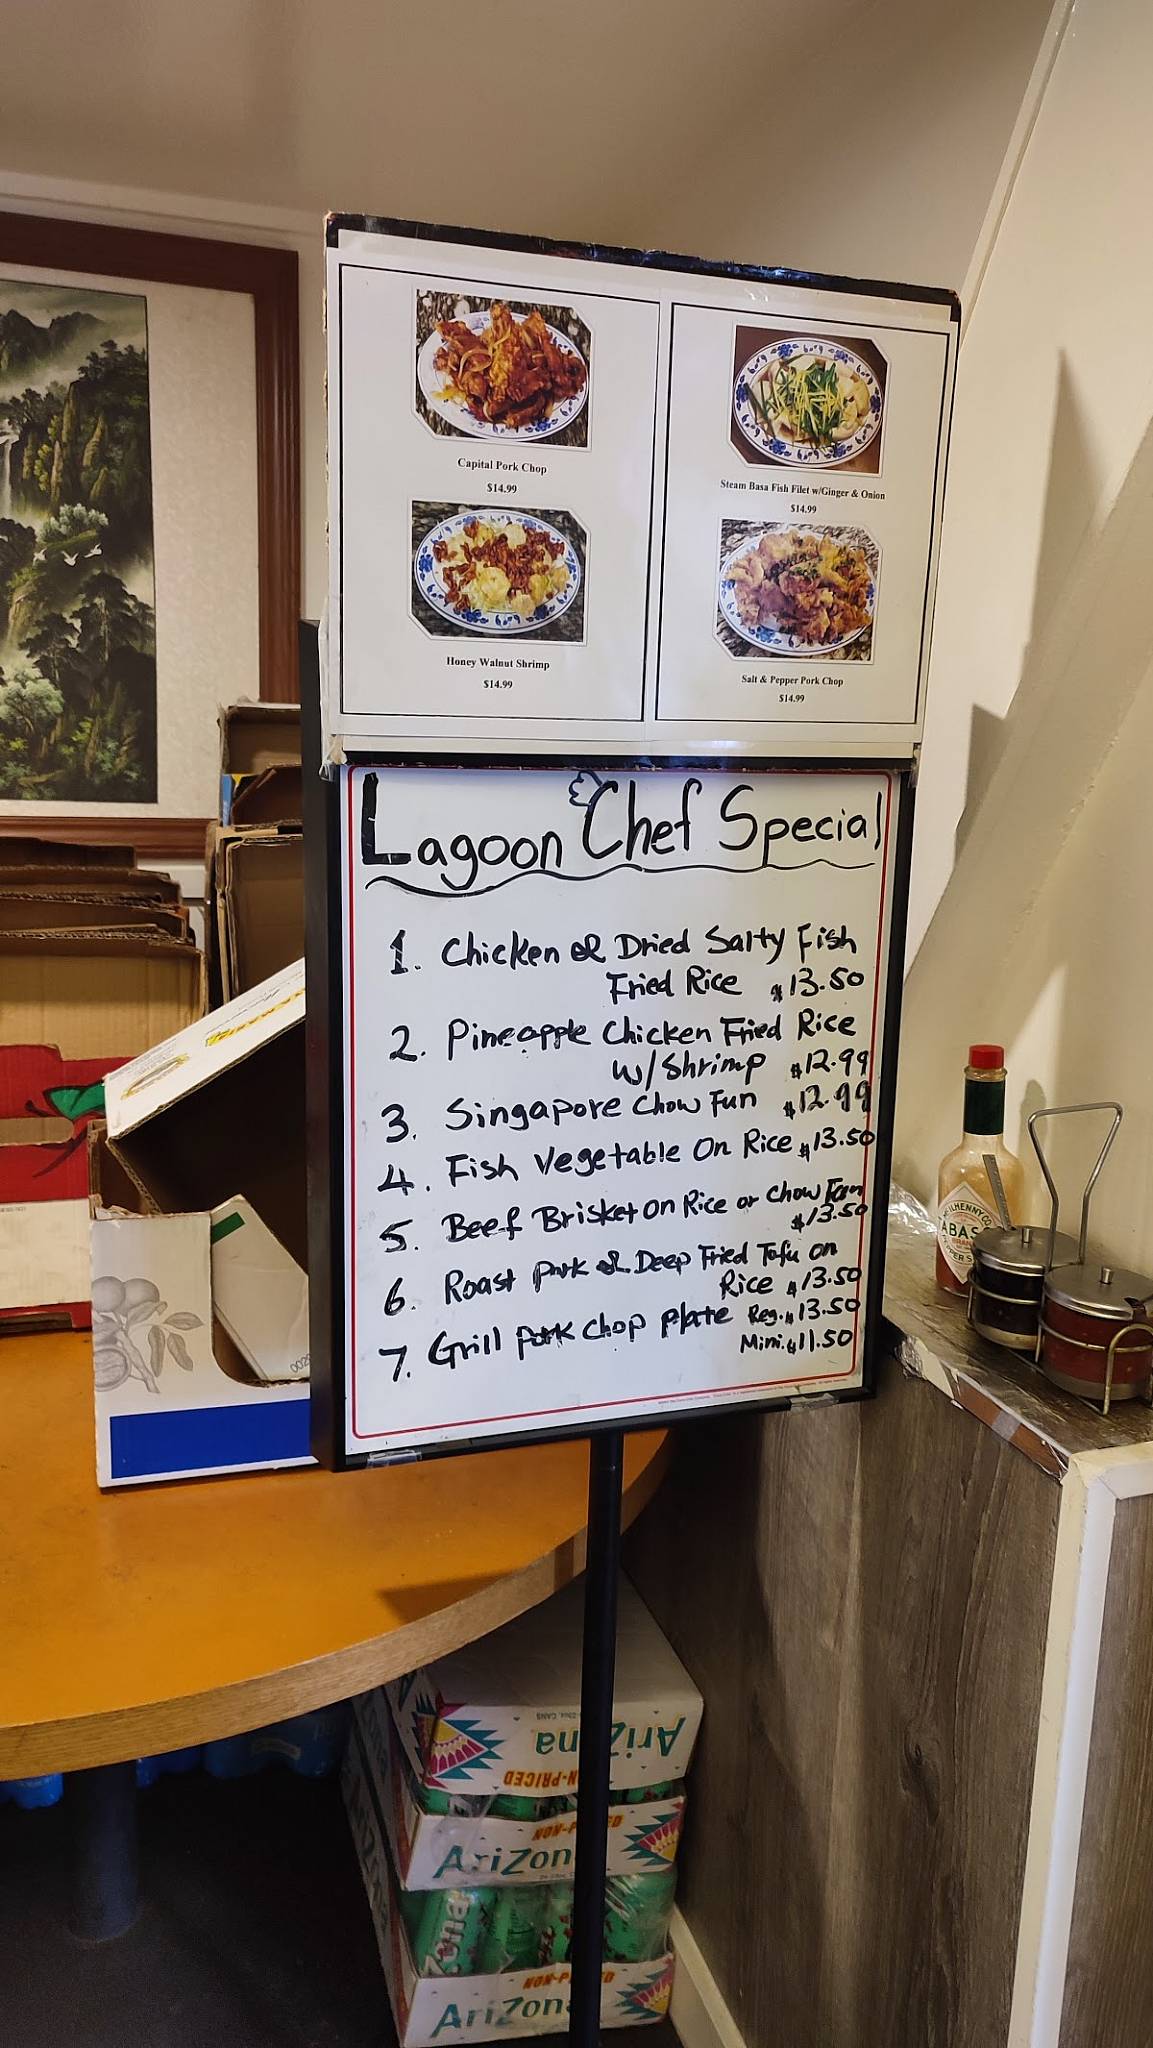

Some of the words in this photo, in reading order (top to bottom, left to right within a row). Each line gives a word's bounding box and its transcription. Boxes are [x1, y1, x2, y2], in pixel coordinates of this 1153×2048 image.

[458, 457, 493, 470] Capital
[496, 460, 519, 471] Pork
[521, 463, 547, 476] Chop
[487, 483, 517, 494] $14.99
[720, 479, 746, 490] Steam
[749, 482, 769, 491] Basa
[771, 483, 789, 493] Fish
[791, 484, 810, 495] Filet
[812, 486, 849, 499] w/Ginger
[851, 489, 859, 498] &
[861, 489, 886, 500] Onion
[790, 504, 817, 514] $14.99
[446, 656, 476, 668] Honey
[480, 658, 513, 668] Walnut
[516, 659, 550, 671] Shrimp
[483, 680, 513, 689] $14.99
[741, 674, 758, 683] Salt
[760, 675, 767, 683] &
[770, 675, 798, 686] Pepper
[800, 676, 820, 685] Pork
[822, 676, 844, 687] Chop
[779, 694, 805, 703] $14.99
[361, 773, 563, 890] Lagoon
[583, 778, 703, 861] Chef
[719, 784, 883, 867] Special
[390, 929, 421, 975] 1.
[441, 930, 560, 970] Chicken
[614, 928, 690, 960] Dried
[705, 925, 785, 965] Salty
[797, 923, 857, 964] Fish
[606, 969, 675, 1005] Fried
[686, 965, 743, 996] Rice
[770, 966, 865, 1003] $13.50
[389, 1025, 426, 1062] 2.
[448, 1018, 592, 1061] Pineapple
[602, 1015, 712, 1045] Chicken
[720, 1014, 782, 1047] Fried
[797, 1007, 856, 1041] Rice
[790, 1048, 869, 1080] $12.99
[381, 1103, 417, 1143] 3.
[445, 1097, 622, 1131] Singapore
[709, 1089, 757, 1117] Fun
[783, 1080, 872, 1120] $12.99
[378, 1164, 431, 1196] 4.
[446, 1153, 519, 1187] Fish
[534, 1141, 681, 1177] Vegetable
[693, 1137, 731, 1162] On
[743, 1128, 793, 1159] Rice
[797, 1127, 876, 1162] $13.50
[379, 1219, 419, 1252] 5.
[441, 1206, 523, 1242] Beef
[531, 1198, 638, 1232] Brisket
[683, 1189, 728, 1218] Rice
[737, 1195, 760, 1210] or
[790, 1202, 868, 1233] $13.50
[941, 1220, 990, 1240] ABAS
[384, 1277, 416, 1316] 6.
[445, 1268, 516, 1305] Roast
[633, 1249, 691, 1275] Deep
[698, 1241, 749, 1270] Fried
[757, 1240, 800, 1267] Tofu
[808, 1241, 838, 1260] on
[719, 1269, 773, 1299] Rice
[786, 1266, 862, 1298] $13.50
[378, 1345, 411, 1382] 7.
[428, 1326, 501, 1369] Grill
[535, 1716, 687, 1759] AriZna
[503, 1769, 578, 1788] N-PRICED
[532, 1814, 624, 1841] NON-PD
[432, 1845, 572, 1879] AriZon
[522, 1971, 616, 1990] NON-PD
[430, 1996, 570, 2039] AriZon
